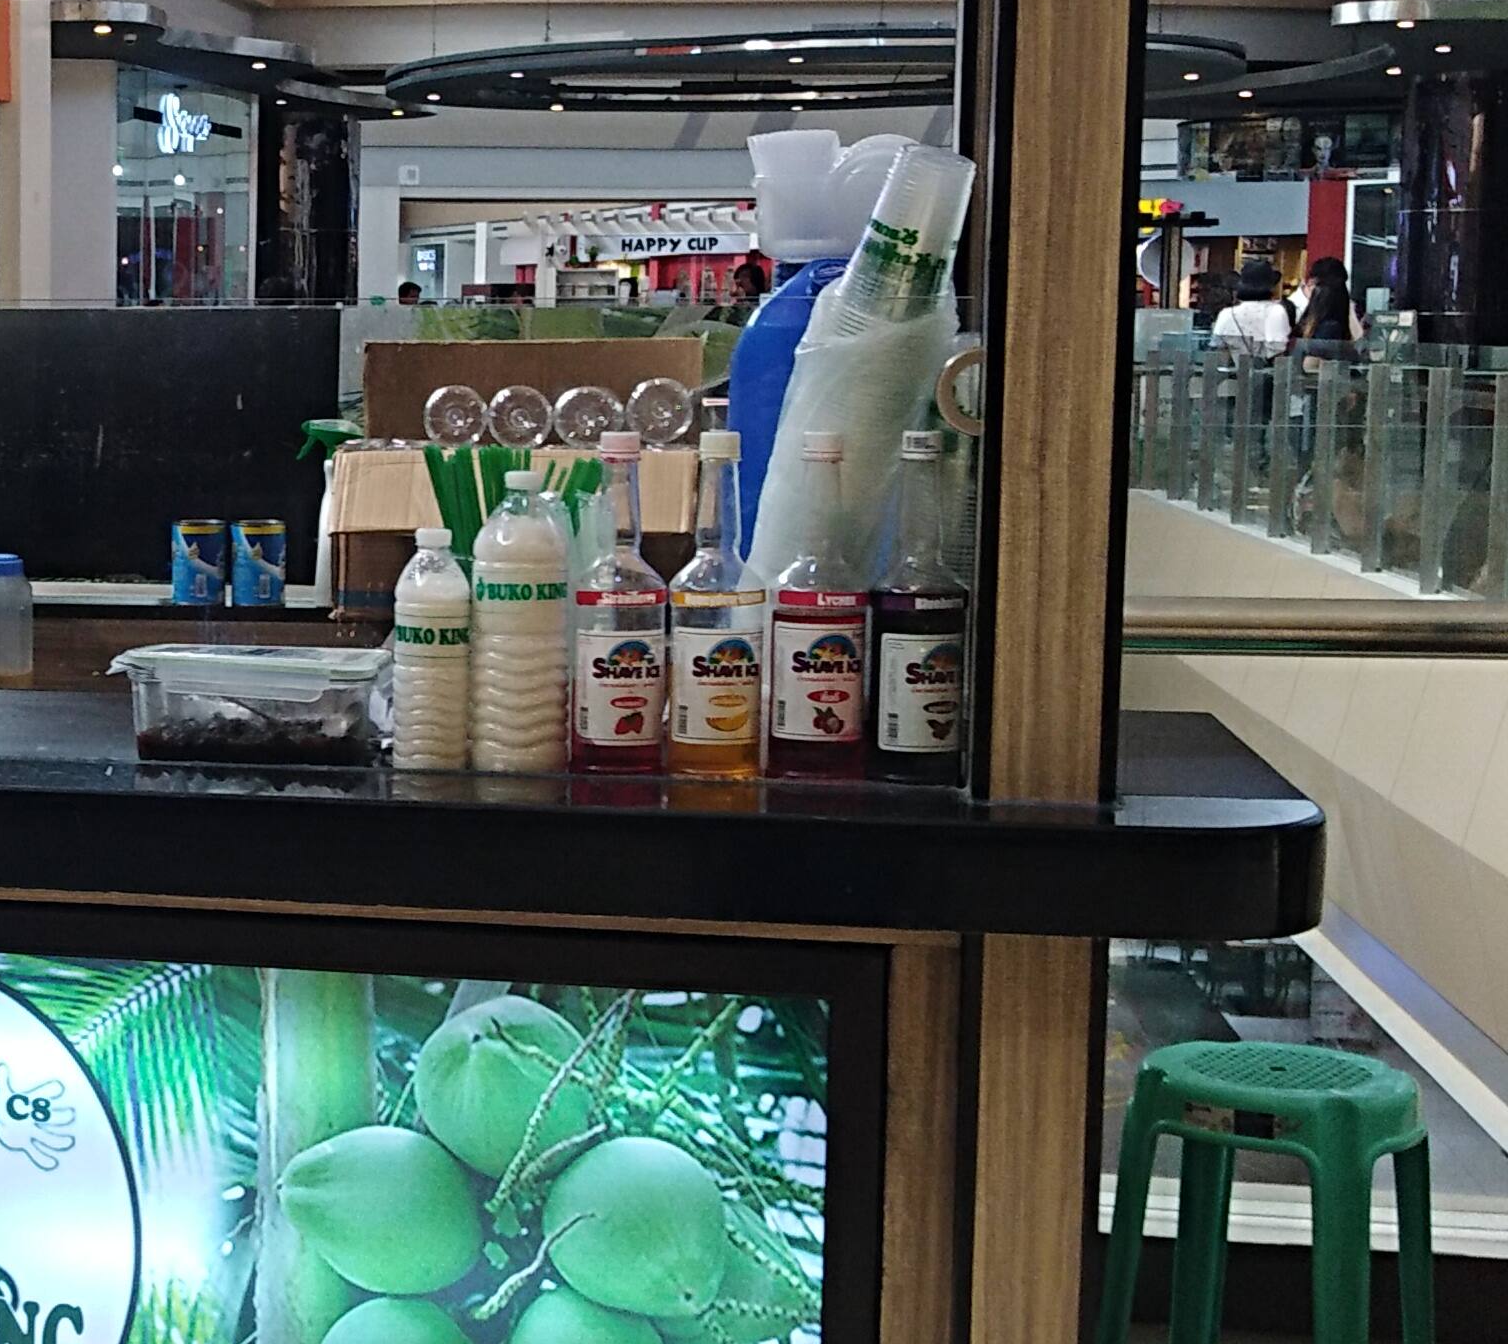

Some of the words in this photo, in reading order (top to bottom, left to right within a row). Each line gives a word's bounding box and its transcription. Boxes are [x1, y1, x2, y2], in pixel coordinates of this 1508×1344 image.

[622, 238, 681, 252] HAPPY
[687, 238, 719, 251] CUP
[488, 584, 532, 600] BUKO
[6, 1094, 53, 1122] C8
